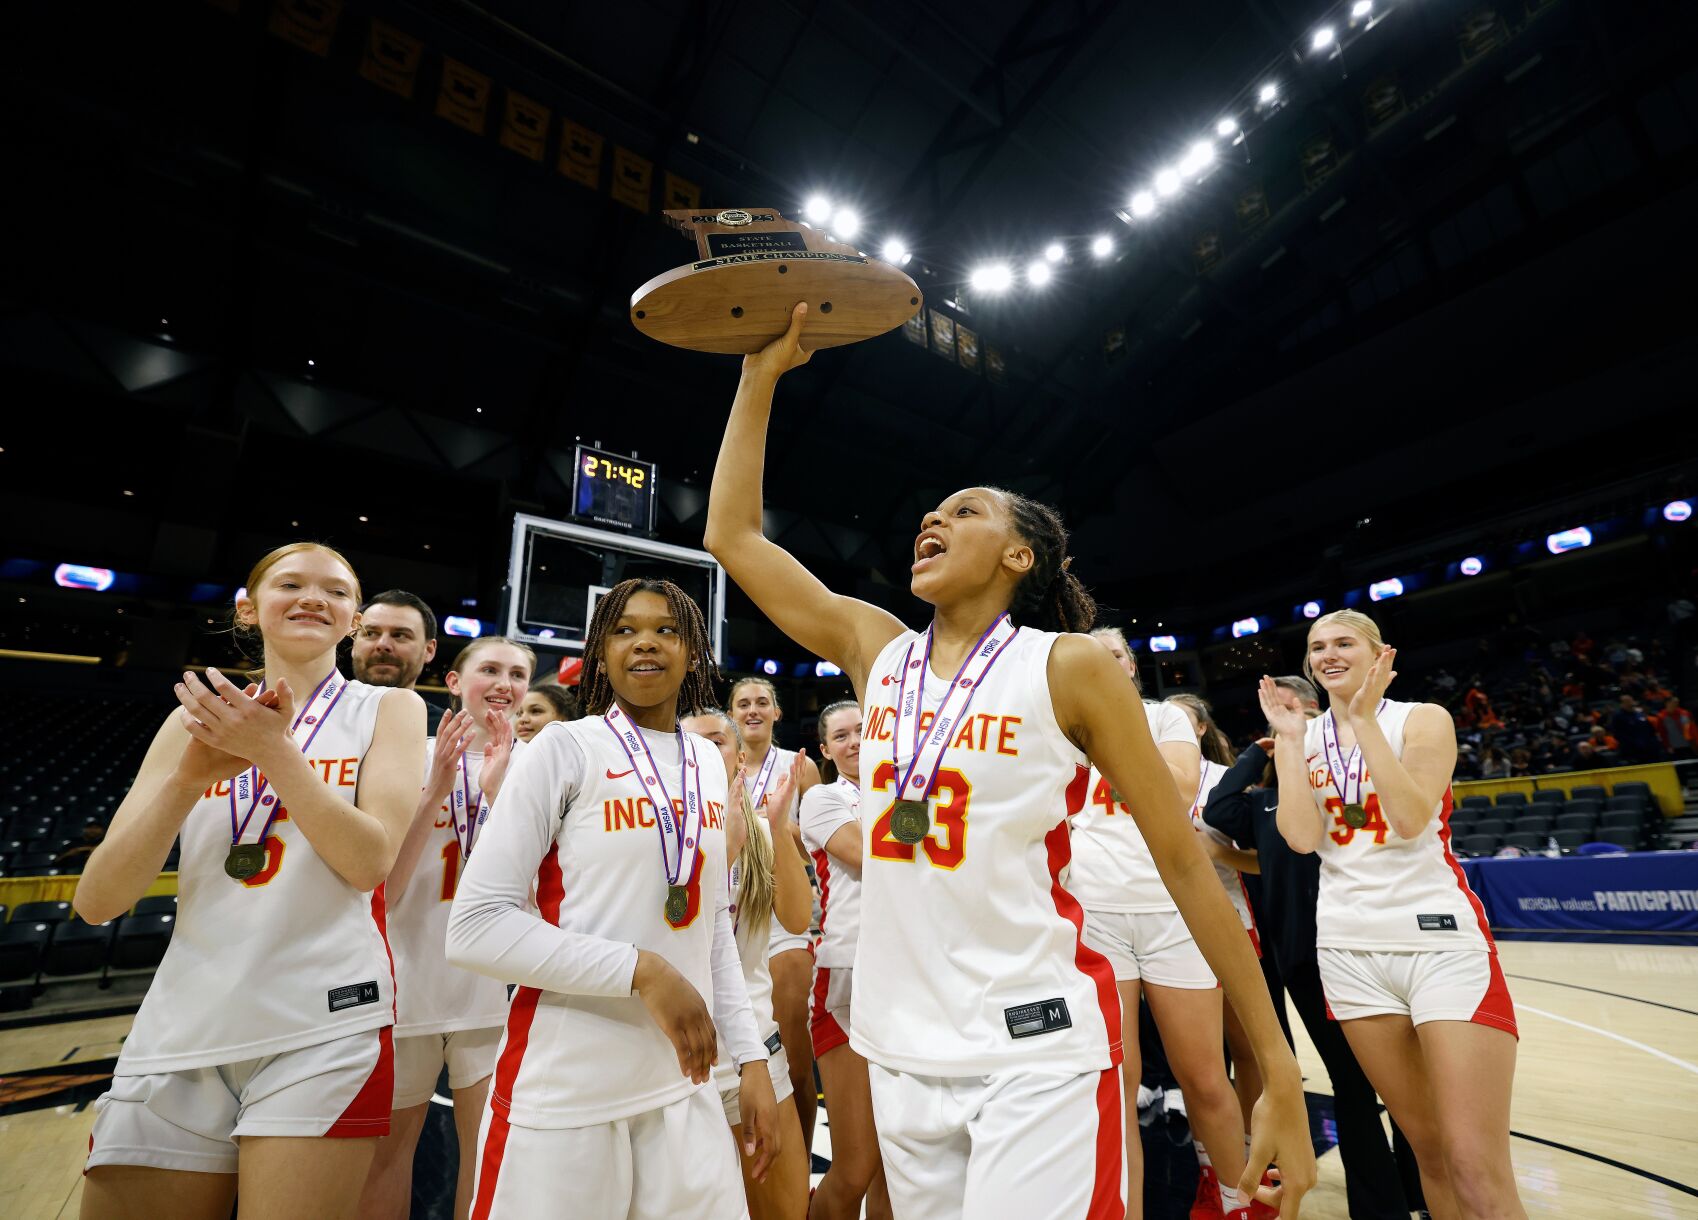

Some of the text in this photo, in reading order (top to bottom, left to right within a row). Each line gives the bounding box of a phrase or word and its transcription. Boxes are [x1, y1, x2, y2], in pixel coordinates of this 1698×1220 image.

[716, 252, 847, 265] STATE CHAMPIONS
[720, 241, 793, 249] BASKETBALL
[584, 455, 645, 489] 27:42
[593, 515, 632, 529] DAKTRONICS
[904, 689, 915, 717] MSHSAA
[929, 716, 952, 746] MSHSAA
[239, 773, 249, 800] MSHSAA
[1092, 776, 1131, 816] 4
[660, 806, 674, 834] MSHSAA
[870, 760, 973, 872] 23
[1324, 793, 1390, 846] 34
[1561, 897, 1597, 912] values
[1443, 918, 1452, 926] M
[364, 987, 373, 997] M
[1049, 1007, 1061, 1021] M
